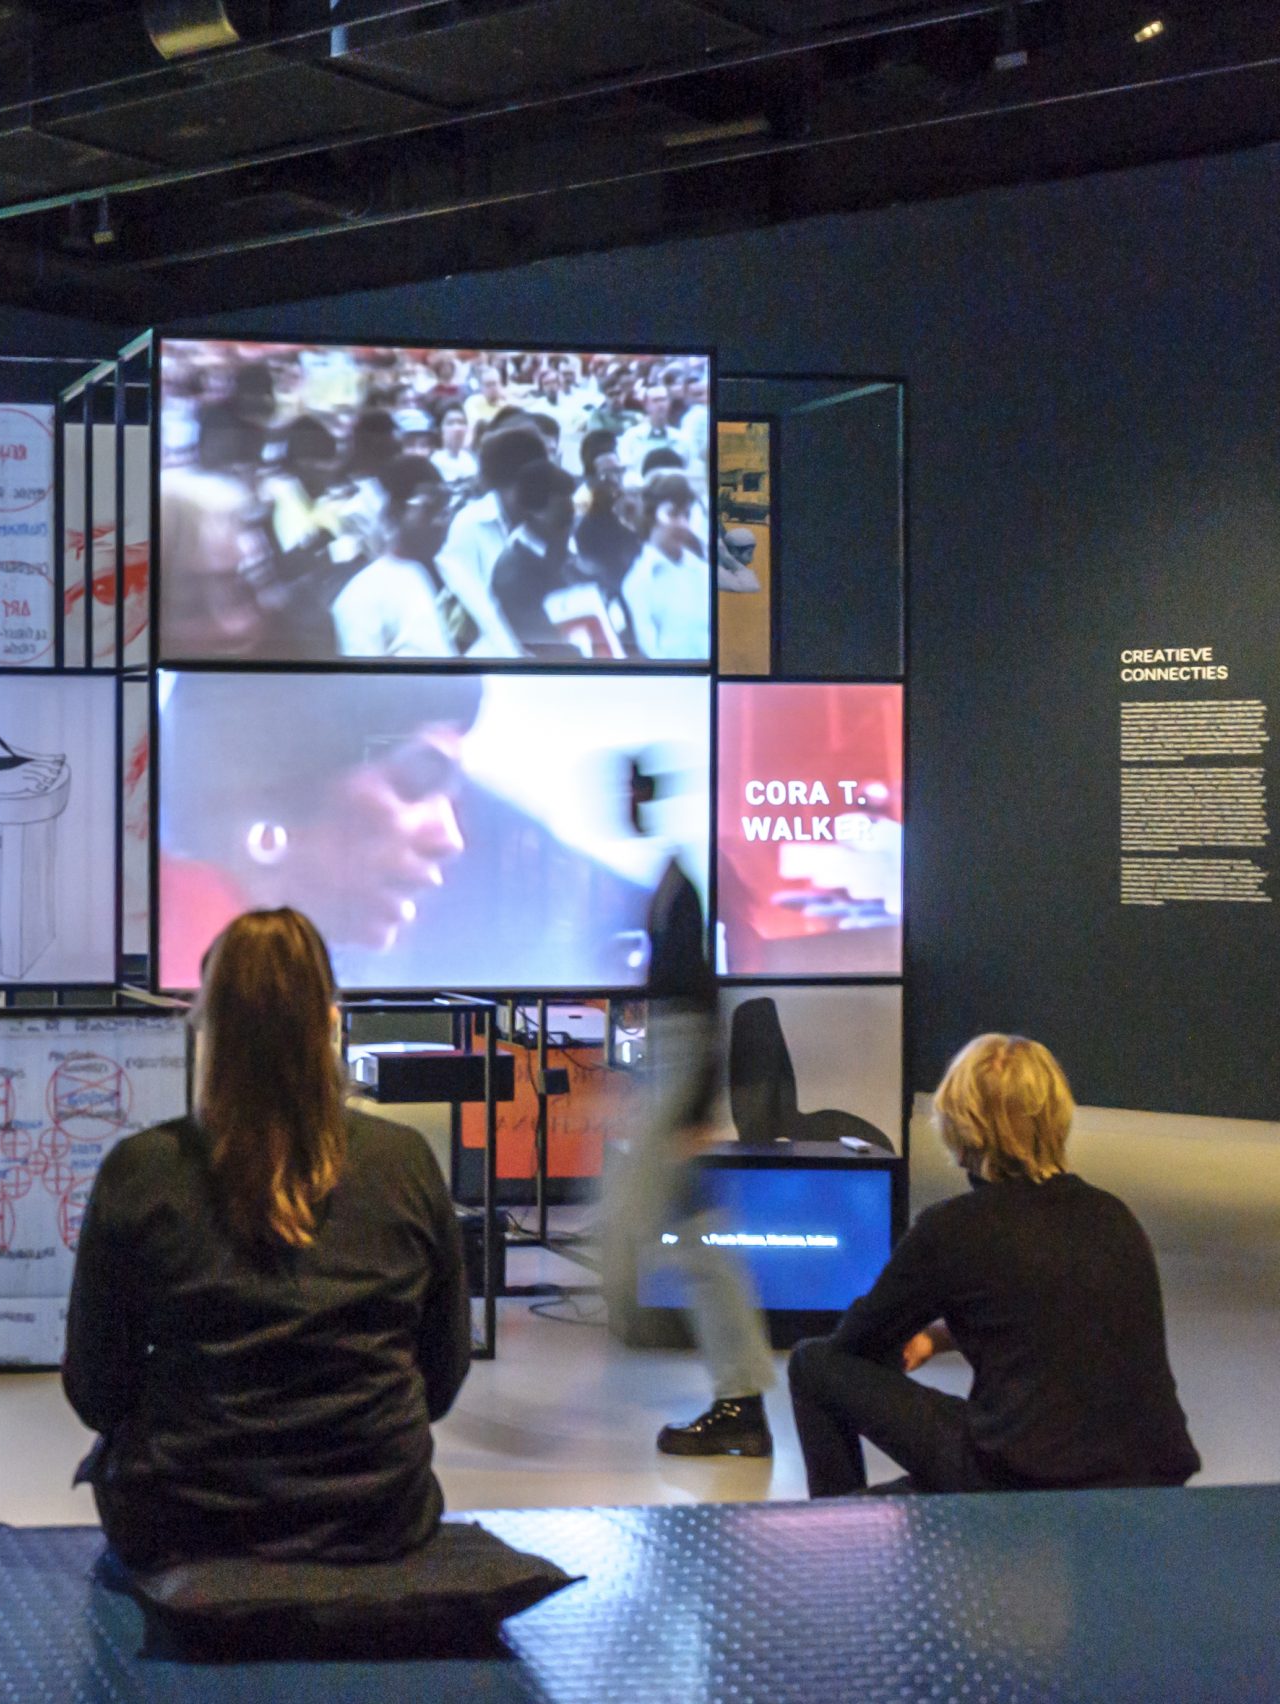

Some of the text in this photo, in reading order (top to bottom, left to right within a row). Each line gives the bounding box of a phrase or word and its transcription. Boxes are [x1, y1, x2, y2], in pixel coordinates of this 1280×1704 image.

[1120, 647, 1213, 664] CREATIEVE
[1120, 665, 1228, 682] CONNECTIES
[745, 780, 866, 805] CORA T.
